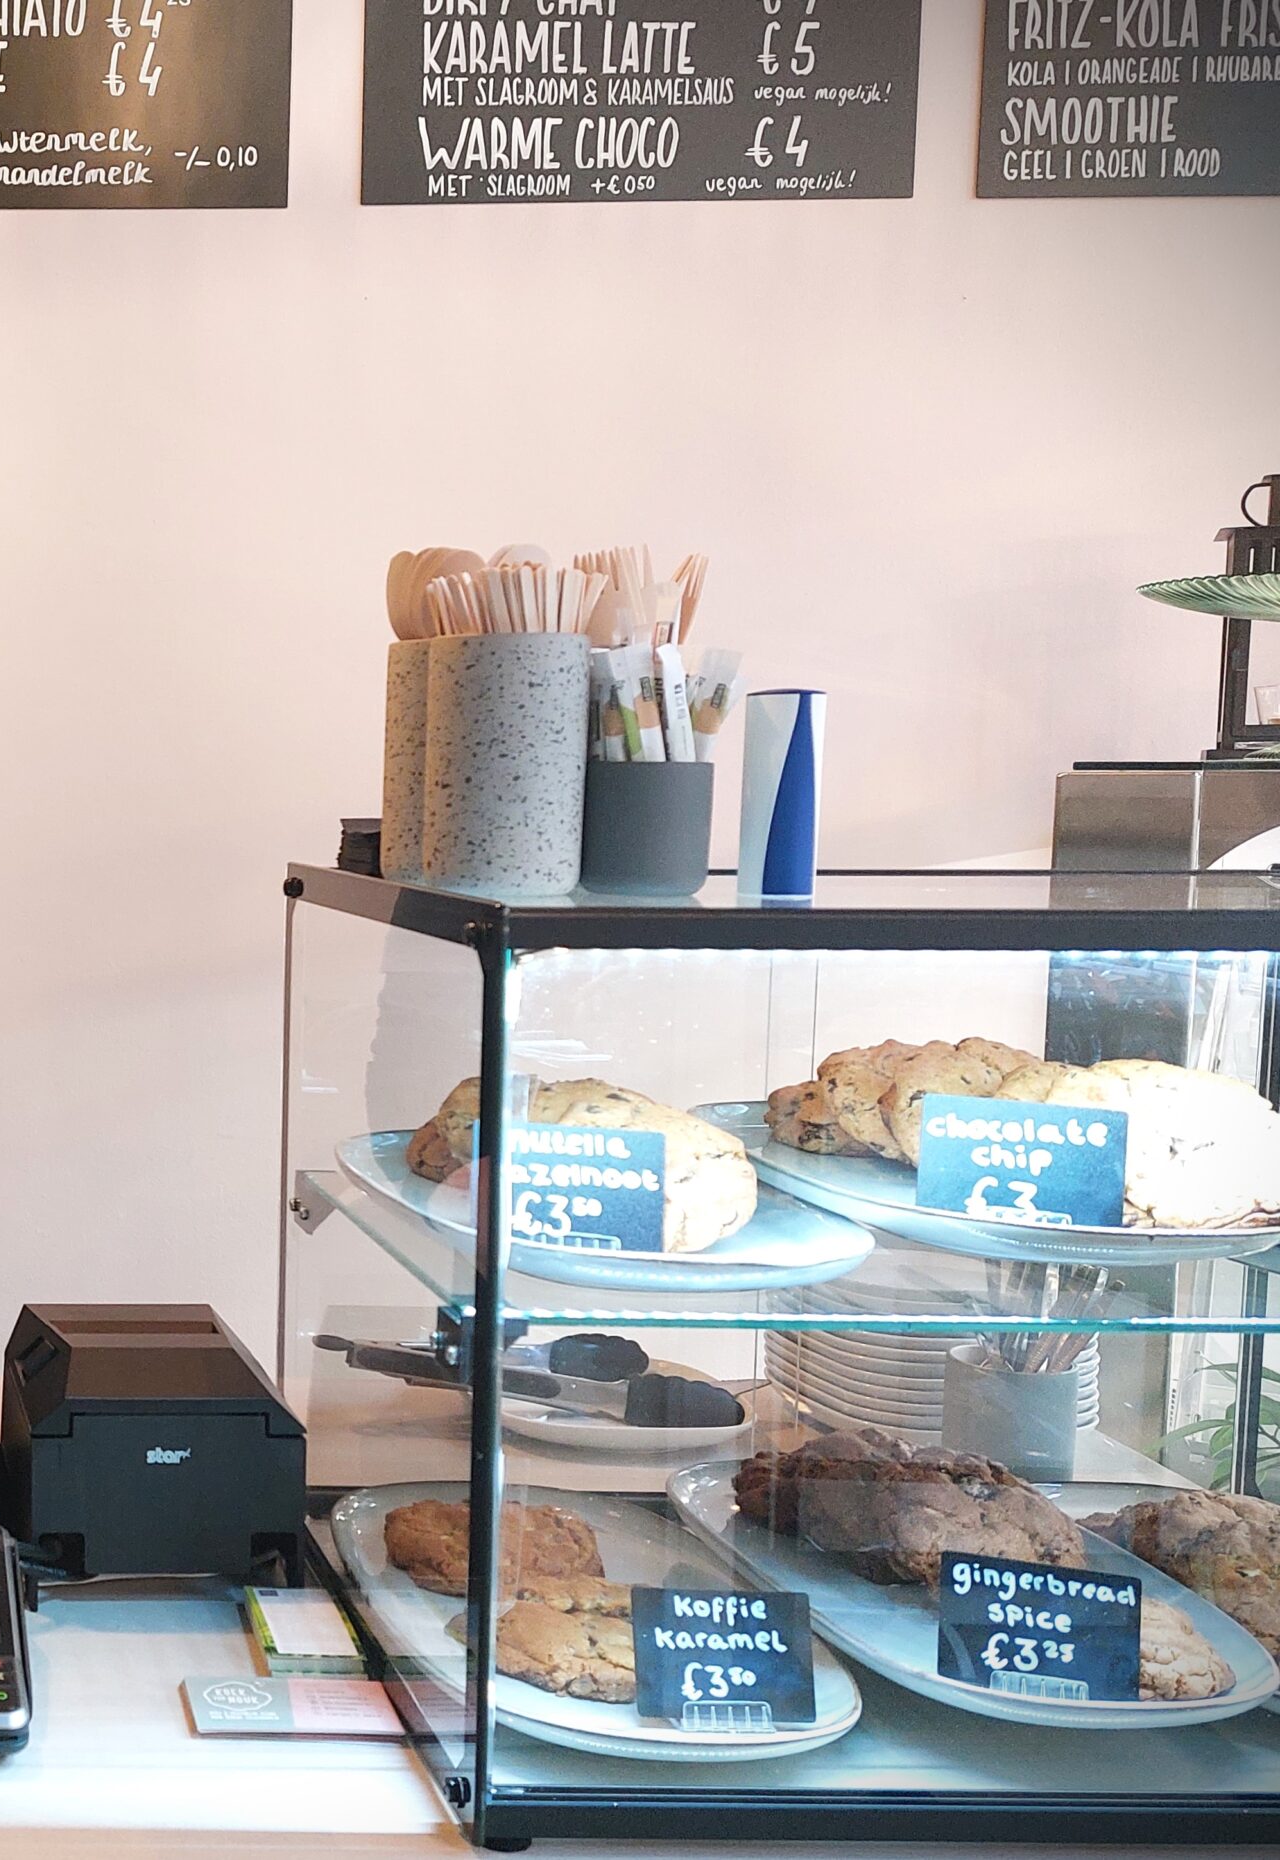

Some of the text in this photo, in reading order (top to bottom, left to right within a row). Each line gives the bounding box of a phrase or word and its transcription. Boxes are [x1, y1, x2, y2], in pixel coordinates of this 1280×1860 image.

[1008, 0, 1199, 50] FRITZ-KOLA
[423, 20, 696, 74] KARAMEL LATTE
[1007, 60, 1056, 86] KOLA
[1077, 57, 1182, 84] ORANGEADE
[423, 76, 469, 106] MET
[475, 78, 578, 106] SLAGROOM
[608, 77, 735, 106] KARAMELSAUS
[754, 85, 806, 106] vegan
[1000, 95, 1178, 146] SMOOTHIE
[418, 116, 679, 170] WARME CHOCO
[1003, 149, 1056, 180] GEEL
[1081, 149, 1146, 179] GROEN
[1173, 148, 1220, 178] ROOD
[428, 175, 472, 197] MET
[487, 175, 570, 197] SLAGROOM
[705, 176, 762, 197] vegan
[925, 1112, 1108, 1148] chocolate
[970, 1144, 1054, 1177] chip
[952, 1562, 1136, 1607] gingerbread
[987, 1602, 1072, 1633] spice
